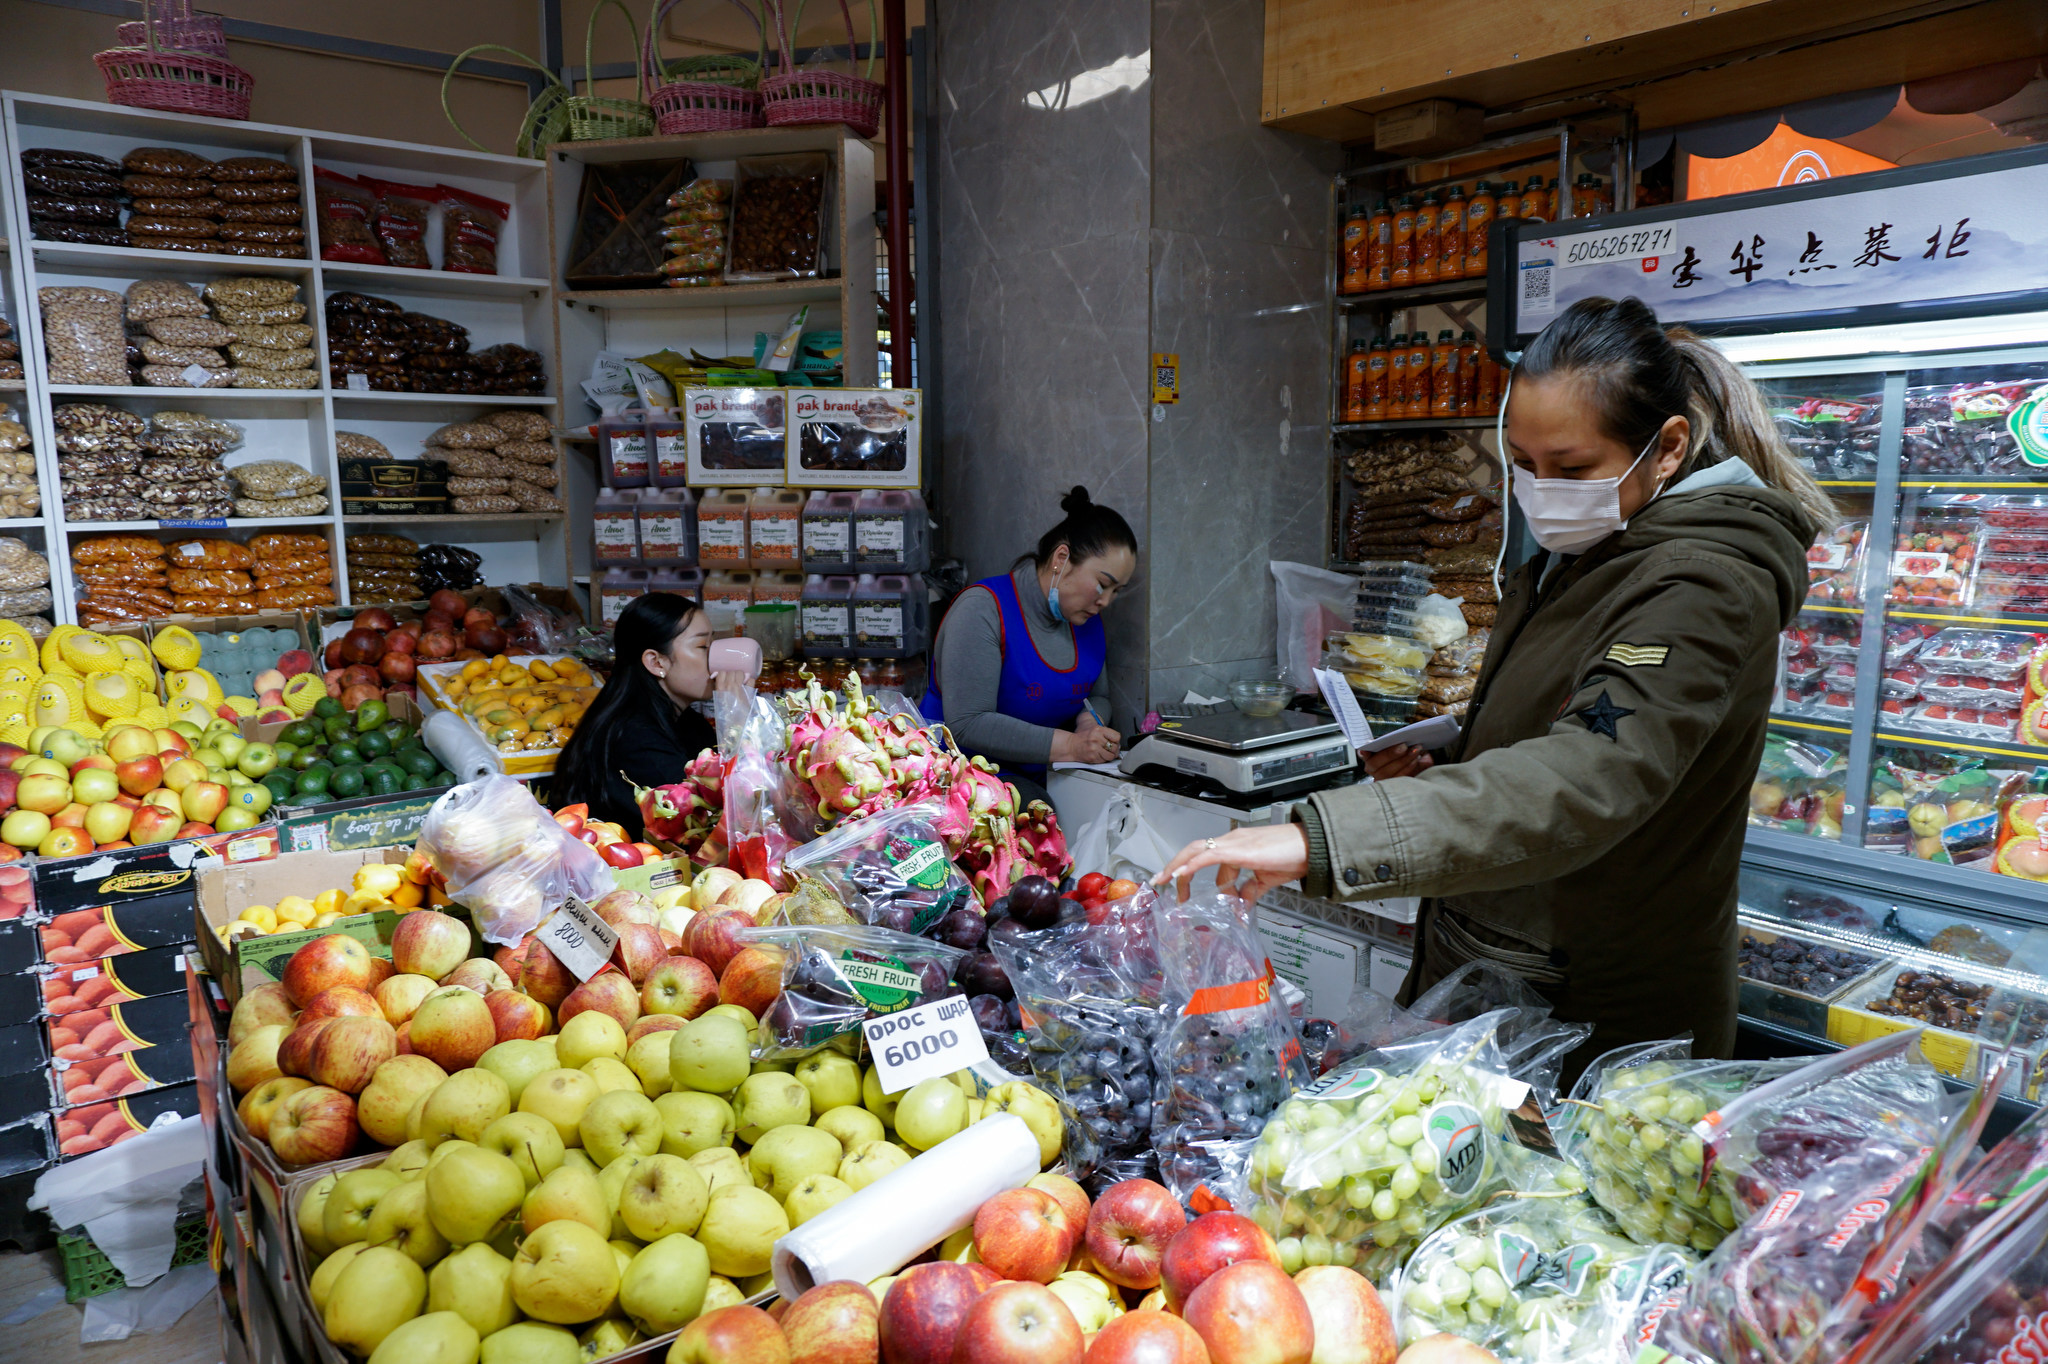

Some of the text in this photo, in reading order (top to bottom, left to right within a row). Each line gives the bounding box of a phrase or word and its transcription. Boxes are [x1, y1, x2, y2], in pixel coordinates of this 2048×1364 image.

[379, 220, 418, 231] ALMONDS
[1567, 228, 1673, 264] 5065267271
[694, 397, 758, 414] pak brand
[796, 397, 859, 414] pak brand
[190, 518, 224, 526] Пекан
[384, 817, 403, 834] de
[899, 844, 943, 877] FRESH FRUIT
[554, 922, 585, 949] 8000
[1322, 948, 1346, 960] ALMONDS
[1379, 957, 1410, 971] ALMENDRAS
[842, 964, 918, 988] FRESH FRUIT
[859, 984, 902, 998] BOUTIQUE
[868, 1001, 891, 1013] FRESH
[892, 998, 911, 1012] FRUIT
[867, 1011, 926, 1042] ОРОС
[936, 999, 970, 1022] ШАР
[884, 1029, 960, 1068] 6000
[1445, 1132, 1483, 1179] MDT
